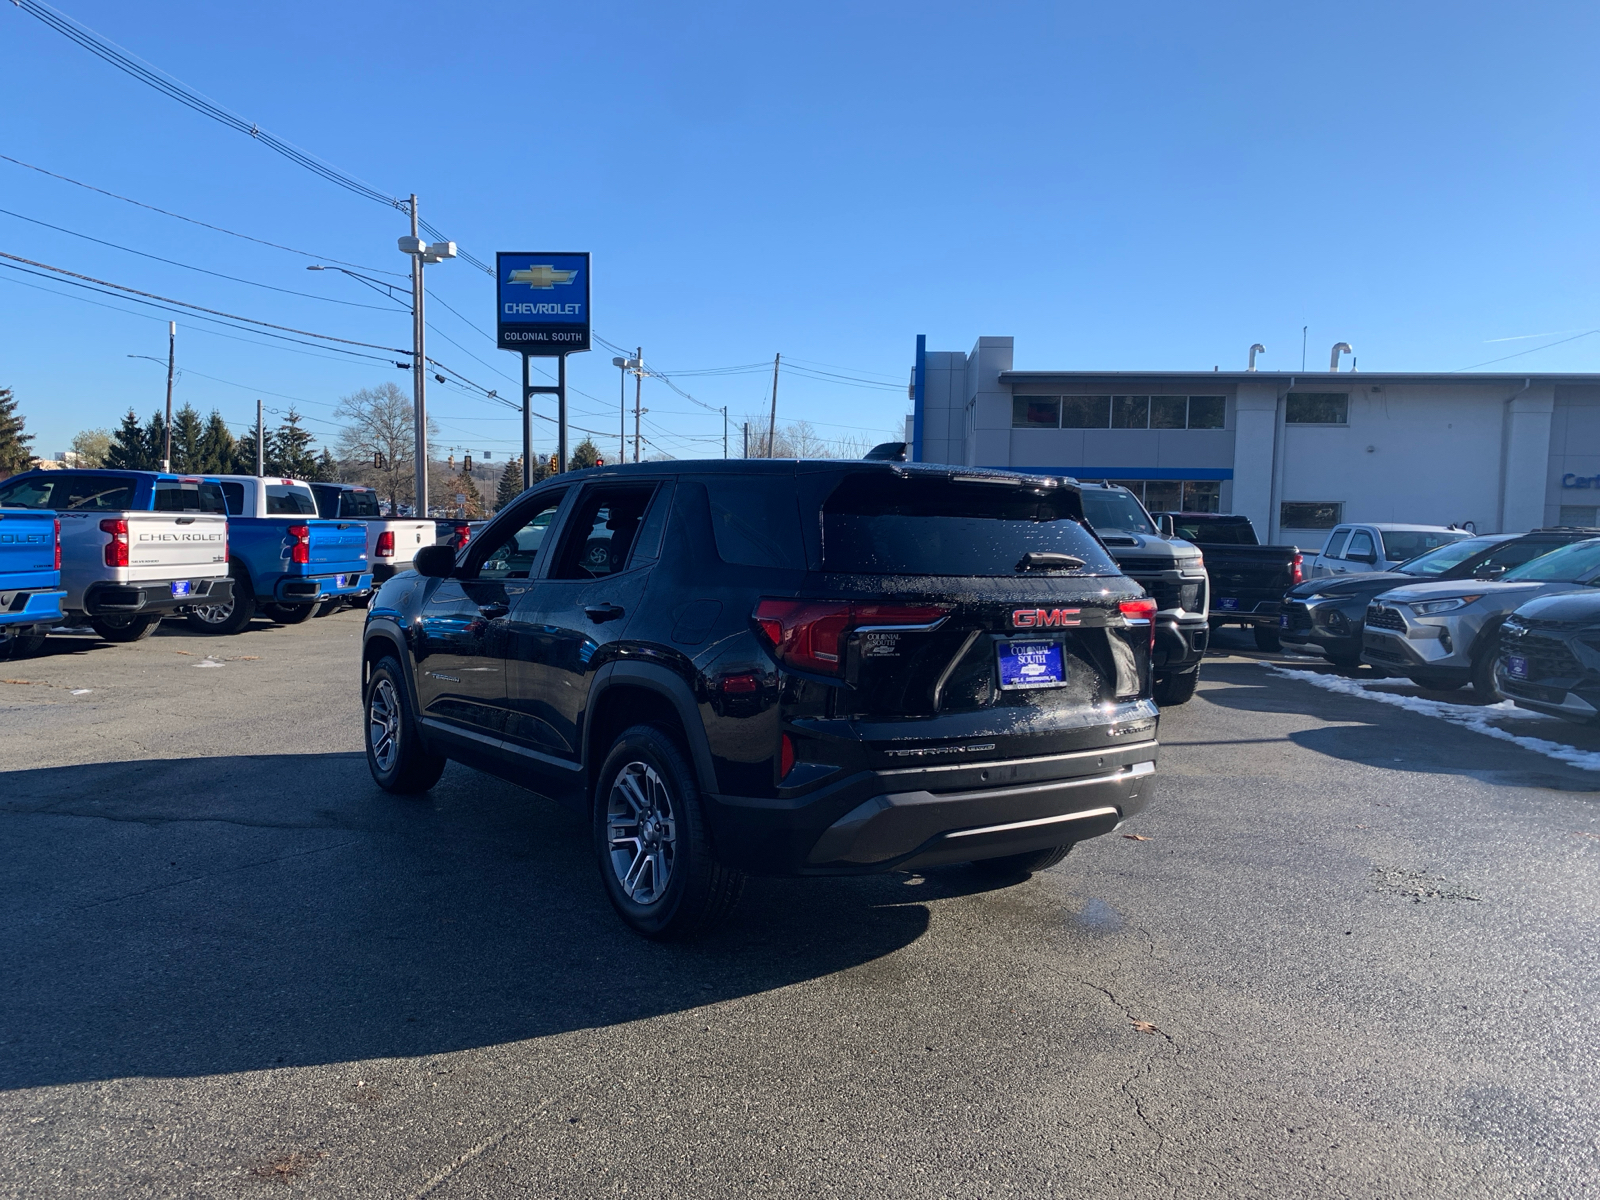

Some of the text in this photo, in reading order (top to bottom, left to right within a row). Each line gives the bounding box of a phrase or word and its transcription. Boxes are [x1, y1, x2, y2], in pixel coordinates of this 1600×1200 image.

[504, 303, 582, 315] CHEVROLET
[504, 332, 582, 341] COLONIAL SOUTH
[139, 533, 223, 542] CHEVROLET
[1012, 608, 1081, 628] GMC
[867, 633, 901, 641] COLONIAL
[1010, 645, 1051, 656] COLONIAL
[1018, 655, 1046, 664] SOUTH
